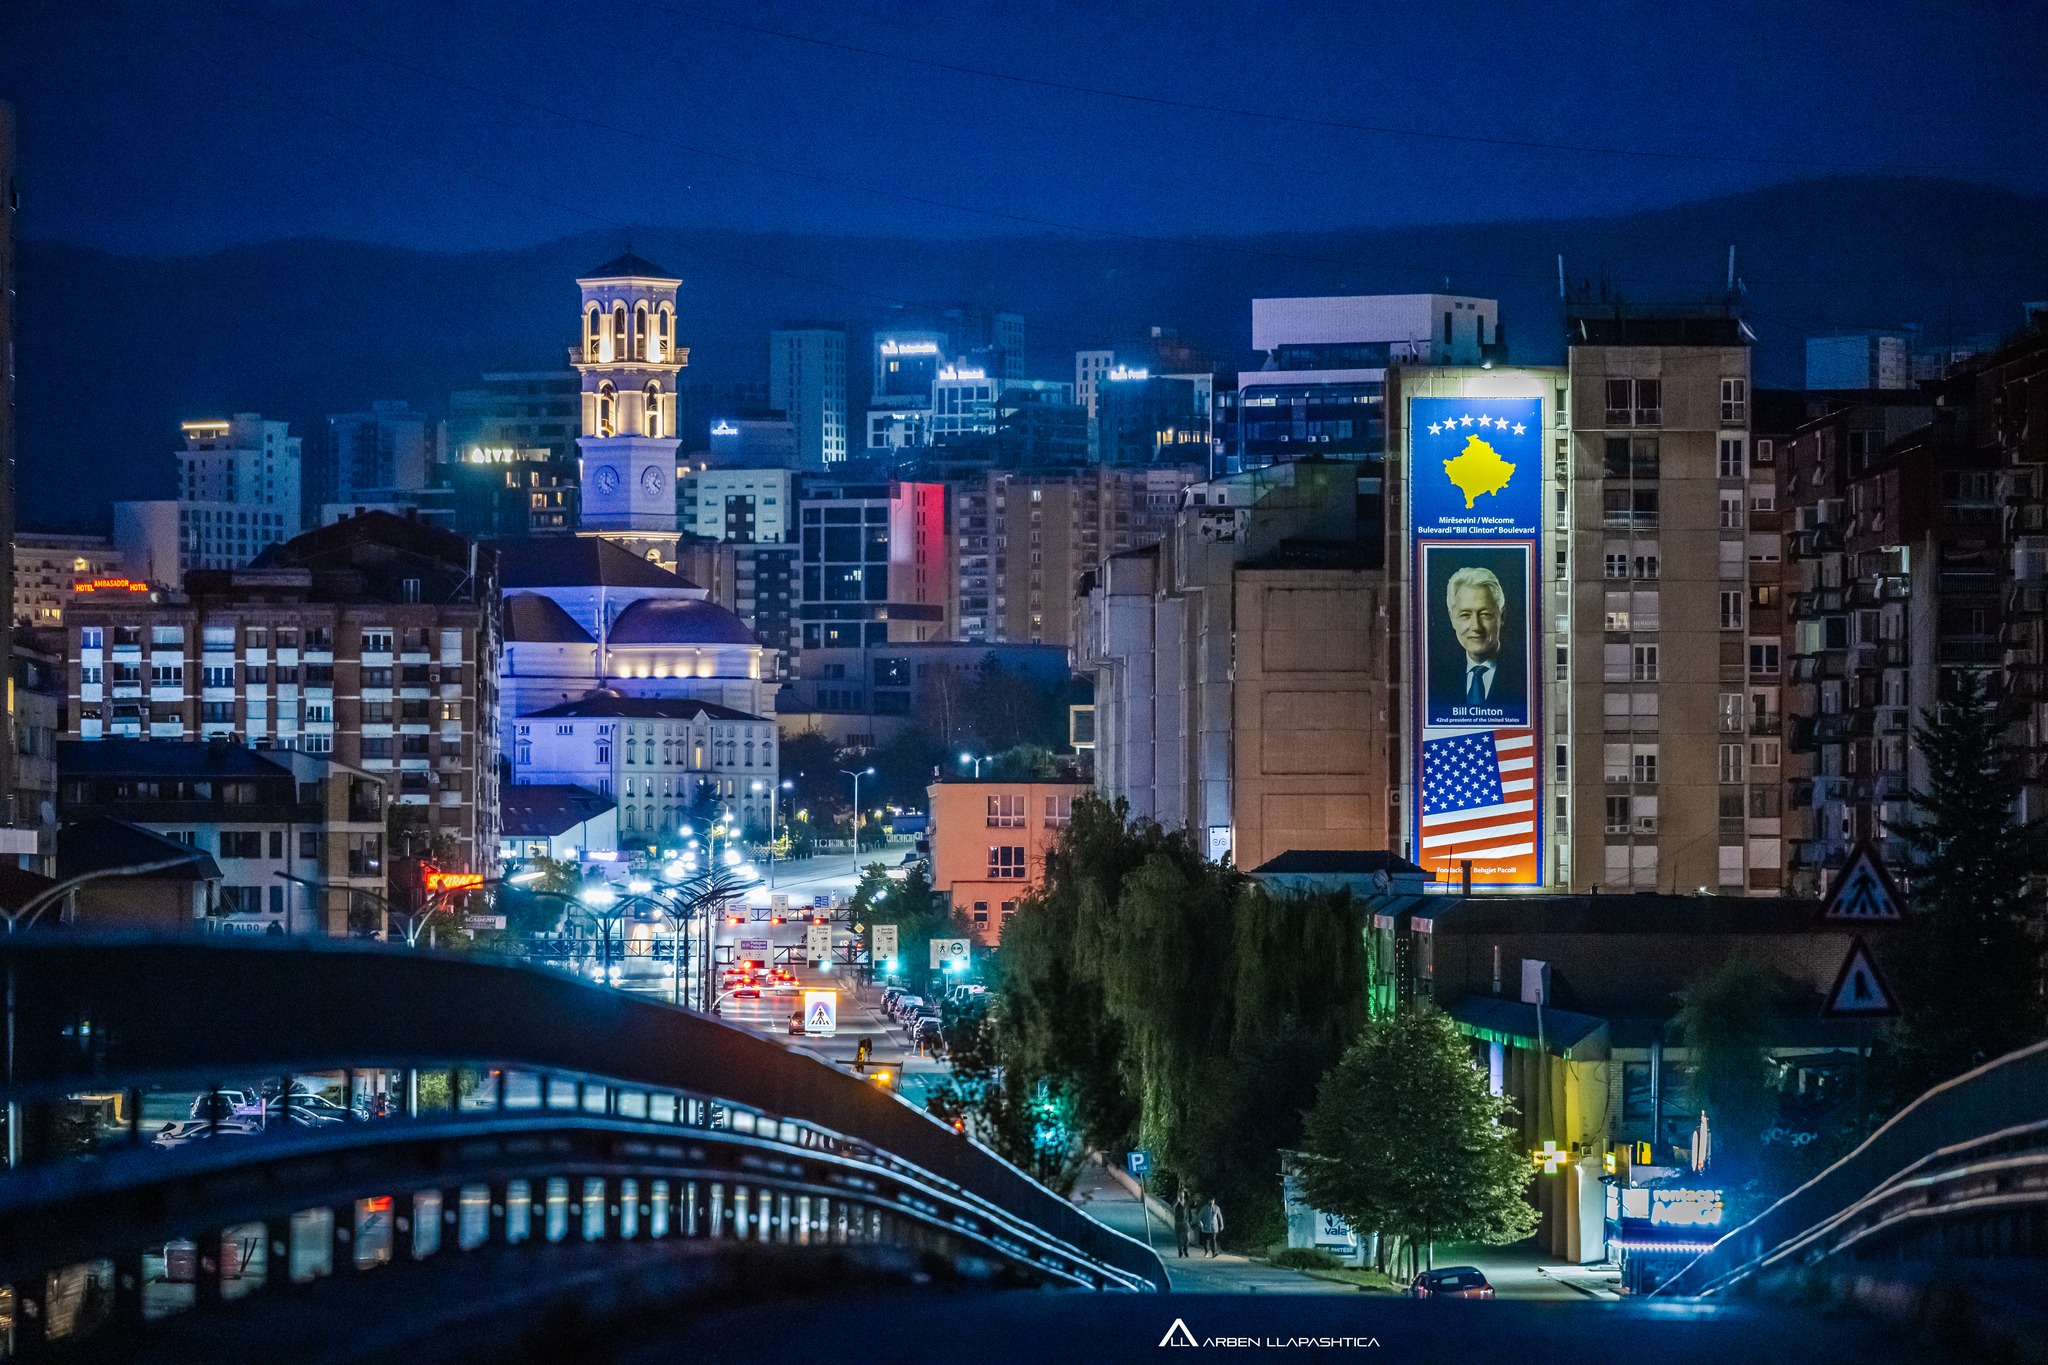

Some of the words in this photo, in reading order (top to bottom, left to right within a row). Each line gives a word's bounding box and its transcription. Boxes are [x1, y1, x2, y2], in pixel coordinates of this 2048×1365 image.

[484, 448, 514, 463] IVY
[1438, 516, 1476, 524] Mirësevini
[1481, 516, 1515, 524] Welcome
[1418, 526, 1452, 534] Bulevardi
[1498, 526, 1535, 534] Boulevard
[75, 584, 95, 592] HOTEL
[94, 579, 129, 588] AMBASADOR
[129, 583, 149, 591] HOTEL
[1452, 706, 1467, 716] Bill
[1469, 706, 1503, 716] Clinton
[1473, 867, 1497, 875] Behgjet
[235, 923, 260, 932] ALDO
[1131, 1153, 1145, 1172] P
[1324, 1225, 1348, 1236] vala
